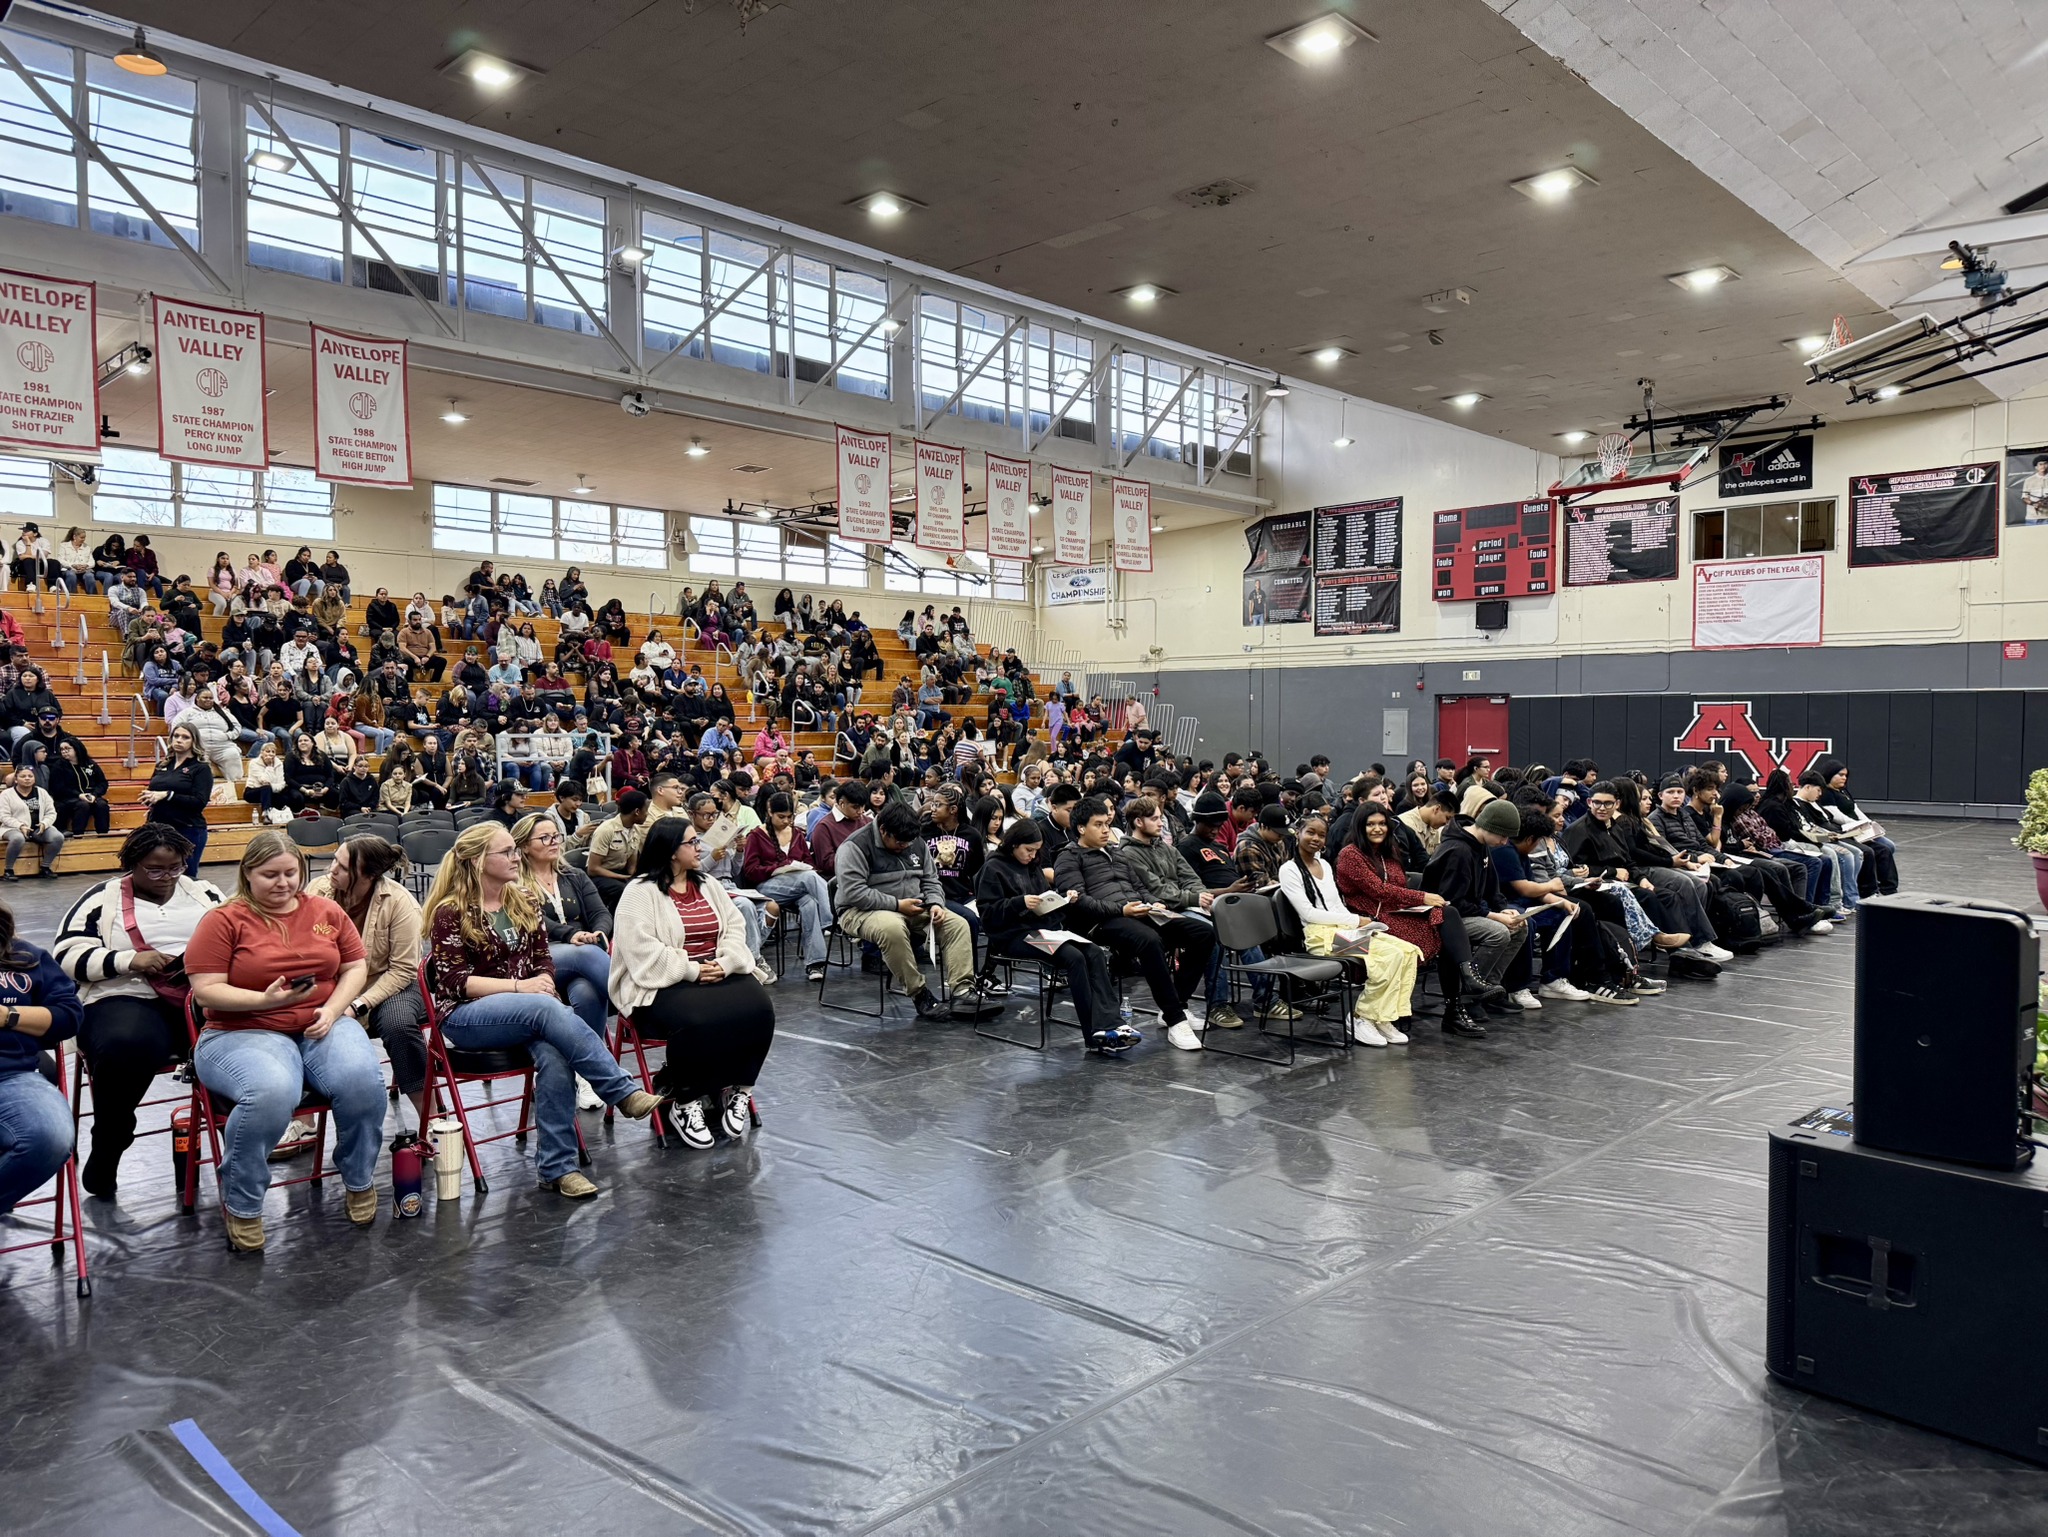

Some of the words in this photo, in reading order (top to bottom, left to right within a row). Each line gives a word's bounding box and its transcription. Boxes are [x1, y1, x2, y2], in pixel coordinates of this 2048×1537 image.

[0, 282, 87, 311] NTELOPE
[0, 308, 72, 334] VALLEY
[163, 310, 256, 340] ANTELOPE
[178, 336, 244, 361] VALLEY
[320, 338, 401, 365] ANTELOPE
[17, 340, 55, 373] CIF
[333, 363, 390, 385] VALLEY
[23, 381, 50, 393] 1981
[196, 368, 228, 397] CIF
[0, 391, 21, 403] TATE
[24, 395, 83, 411] CHAMPION
[349, 392, 377, 420] CIF
[0, 405, 27, 417] JOHN
[30, 409, 75, 423] FRAZIER
[201, 406, 225, 416] 1987
[12, 420, 41, 432] SHOT
[43, 424, 64, 435] PUT
[172, 414, 200, 426] STATE
[202, 418, 254, 432] CHAMPION
[184, 428, 215, 440] PERCY
[217, 432, 243, 443] KNOX
[353, 427, 375, 437] 1988
[187, 441, 213, 452] LONG
[215, 444, 242, 455] JUMP
[328, 435, 353, 447] STATE
[354, 439, 397, 452] CHAMPION
[840, 435, 887, 453] ANTELOPE
[332, 448, 364, 459] REGGIE
[365, 451, 394, 463] BETTON
[848, 453, 880, 468] VALLEY
[919, 448, 960, 465] ANTELOPE
[342, 461, 363, 471] HIGH
[364, 463, 386, 473] JUMP
[924, 465, 954, 480] VALLEY
[990, 462, 1028, 478] ANTELOPE
[1767, 461, 1801, 471] adidas
[1054, 473, 1089, 488] ANTELOPE
[1738, 478, 1775, 488] antelopes
[1965, 468, 1986, 484] CIF
[995, 478, 1022, 492] VALLEY
[1115, 484, 1148, 498] ANTELOPE
[1858, 478, 1878, 495] AV
[1060, 489, 1084, 502] VALLEY
[845, 507, 859, 515] STATE
[859, 509, 886, 518] CHAMPION
[1120, 499, 1143, 511] VALLEY
[1523, 503, 1549, 513] Guests
[1655, 500, 1670, 515] CIF
[1438, 514, 1458, 523] Home
[1571, 507, 1587, 522] AV
[866, 526, 880, 534] JUMP
[1272, 521, 1306, 531] HONORABLE
[1479, 538, 1502, 550] period
[1478, 553, 1502, 564] player
[1529, 549, 1547, 558] fouls
[1436, 558, 1452, 567] fouls
[1697, 567, 1713, 582] AV
[1725, 568, 1755, 577] PLAYERS
[1756, 567, 1766, 575] OF
[1767, 566, 1780, 574] THE
[1781, 565, 1800, 573] YEAR
[1273, 577, 1304, 586] COMMITTED
[1530, 582, 1545, 590] won
[1051, 587, 1111, 600] CHAMPINSHIP
[1437, 589, 1451, 597] won
[1480, 585, 1499, 595] game
[1673, 701, 1832, 790] AV
